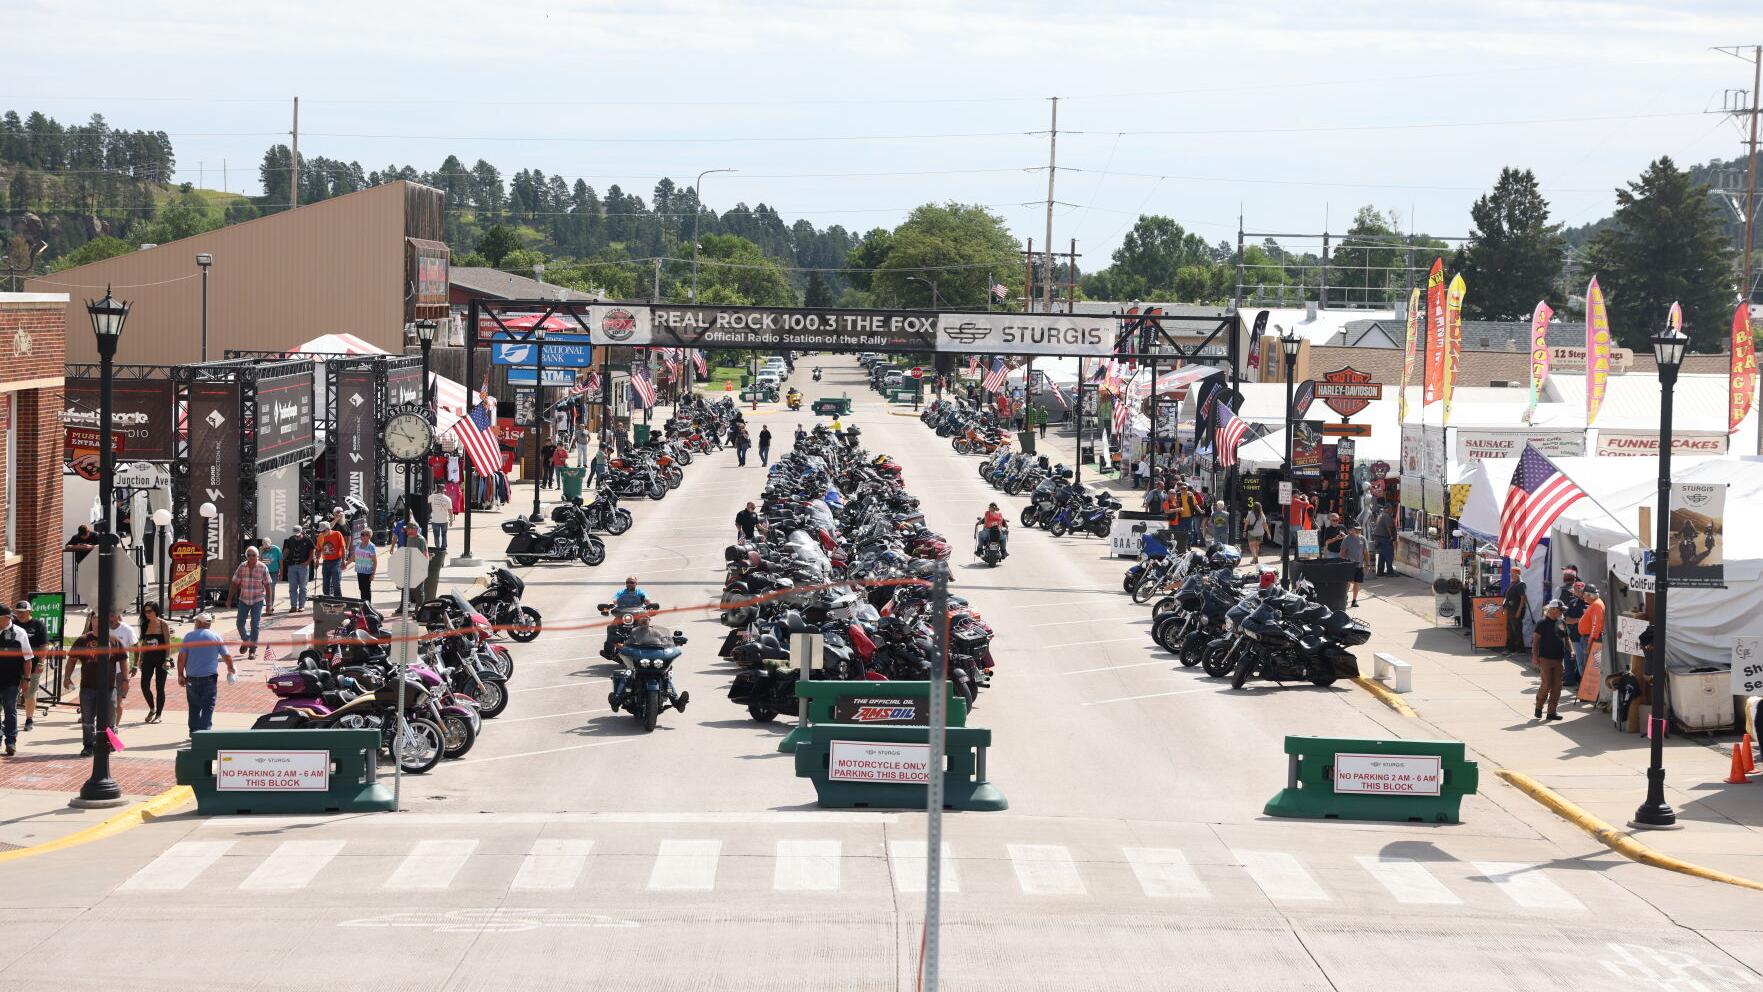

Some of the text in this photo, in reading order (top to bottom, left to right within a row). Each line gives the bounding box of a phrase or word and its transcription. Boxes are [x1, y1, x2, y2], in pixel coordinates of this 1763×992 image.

[655, 311, 934, 333] REAL ROCK 100.3 THE FOX
[704, 333, 744, 342] Official
[749, 333, 779, 343] Radio
[783, 333, 823, 344] Station
[826, 334, 837, 344] of
[840, 334, 857, 344] the
[860, 335, 888, 346] Rally
[1002, 325, 1102, 346] STURGIS
[1554, 349, 1587, 360] 12 Step
[1318, 385, 1378, 396] HARLEY-DAVIDSON
[72, 431, 118, 443] MUSEM
[71, 438, 118, 449] ENTRAE
[1465, 439, 1515, 448] SAUSAGE
[1607, 439, 1719, 449] FUNNE CAKES
[1469, 450, 1508, 459] PHILLY
[116, 475, 169, 486] Junction Ave
[851, 706, 916, 722] AMSOIL
[838, 759, 927, 771] MOTORCYCLE ONLY
[834, 769, 929, 780] PARKING THIS BLOCK
[1339, 772, 1352, 780] NO
[1353, 773, 1390, 781] PARKING
[1391, 773, 1397, 781] 2
[246, 779, 300, 787] THIS BLOCK
[1361, 782, 1414, 791] THIS BLOCK
